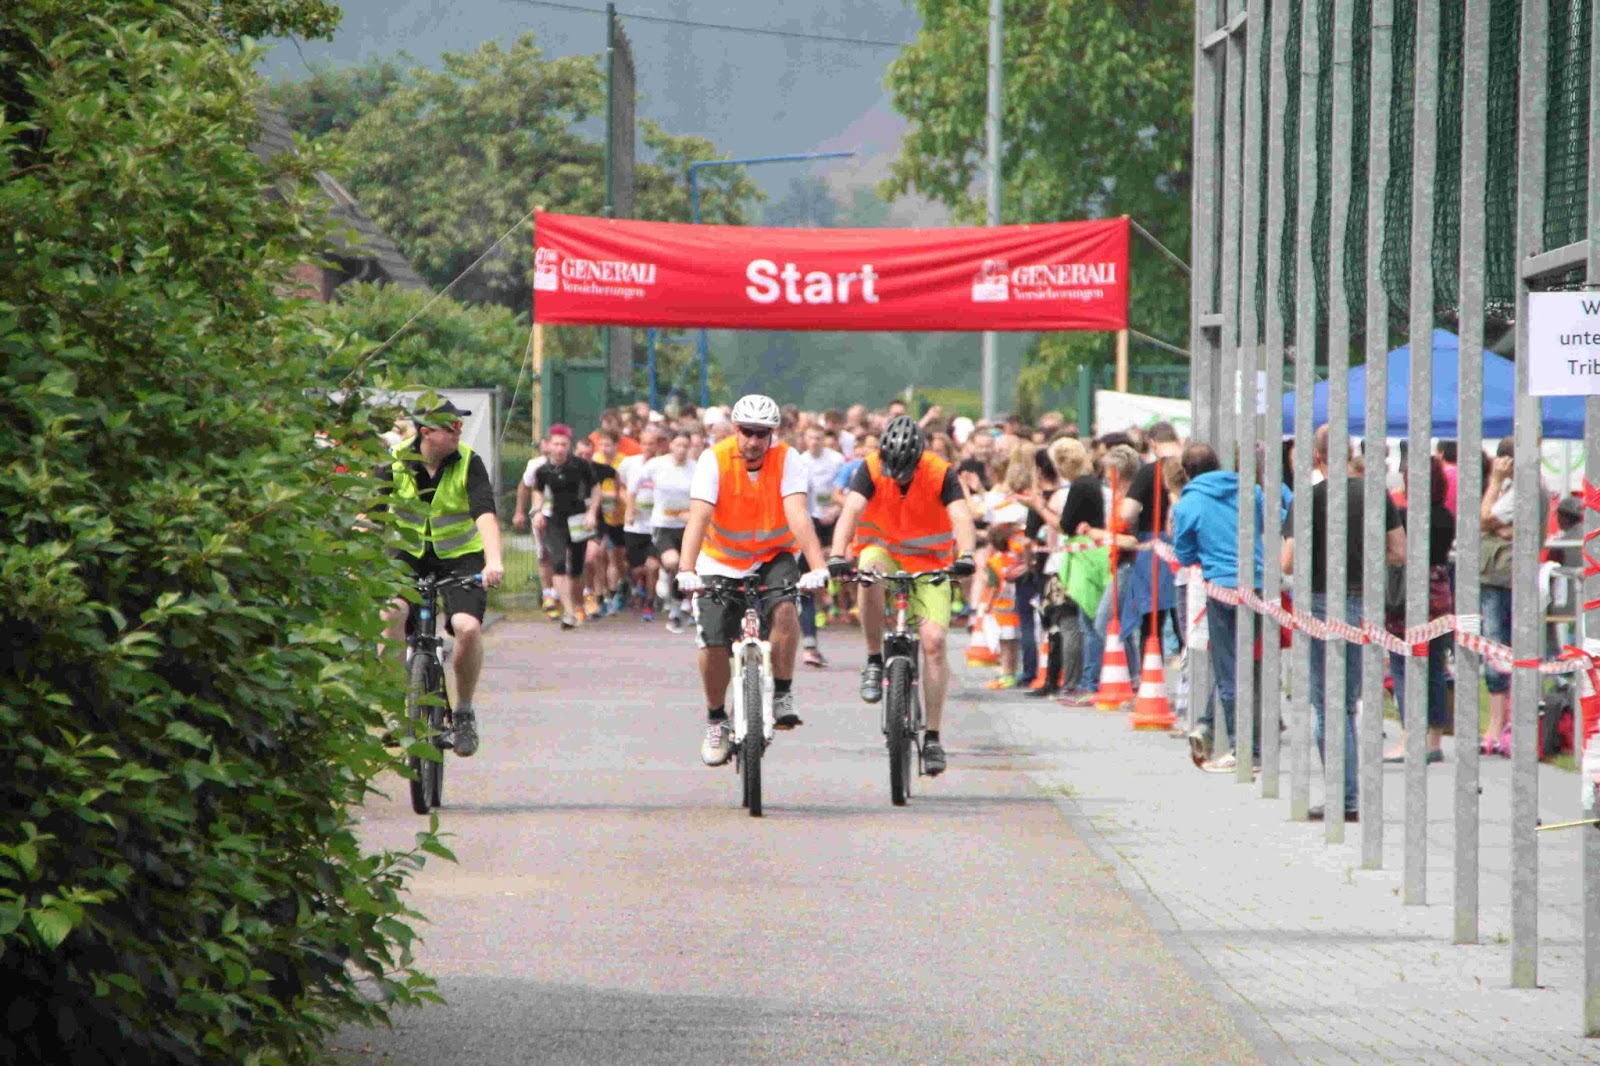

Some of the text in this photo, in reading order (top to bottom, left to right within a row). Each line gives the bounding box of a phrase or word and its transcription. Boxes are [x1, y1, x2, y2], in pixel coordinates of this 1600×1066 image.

[561, 257, 657, 285] GENERALI
[745, 258, 880, 304] Start
[1011, 262, 1117, 286] GENERALI
[1582, 300, 1600, 315] W
[1560, 331, 1600, 346] unte
